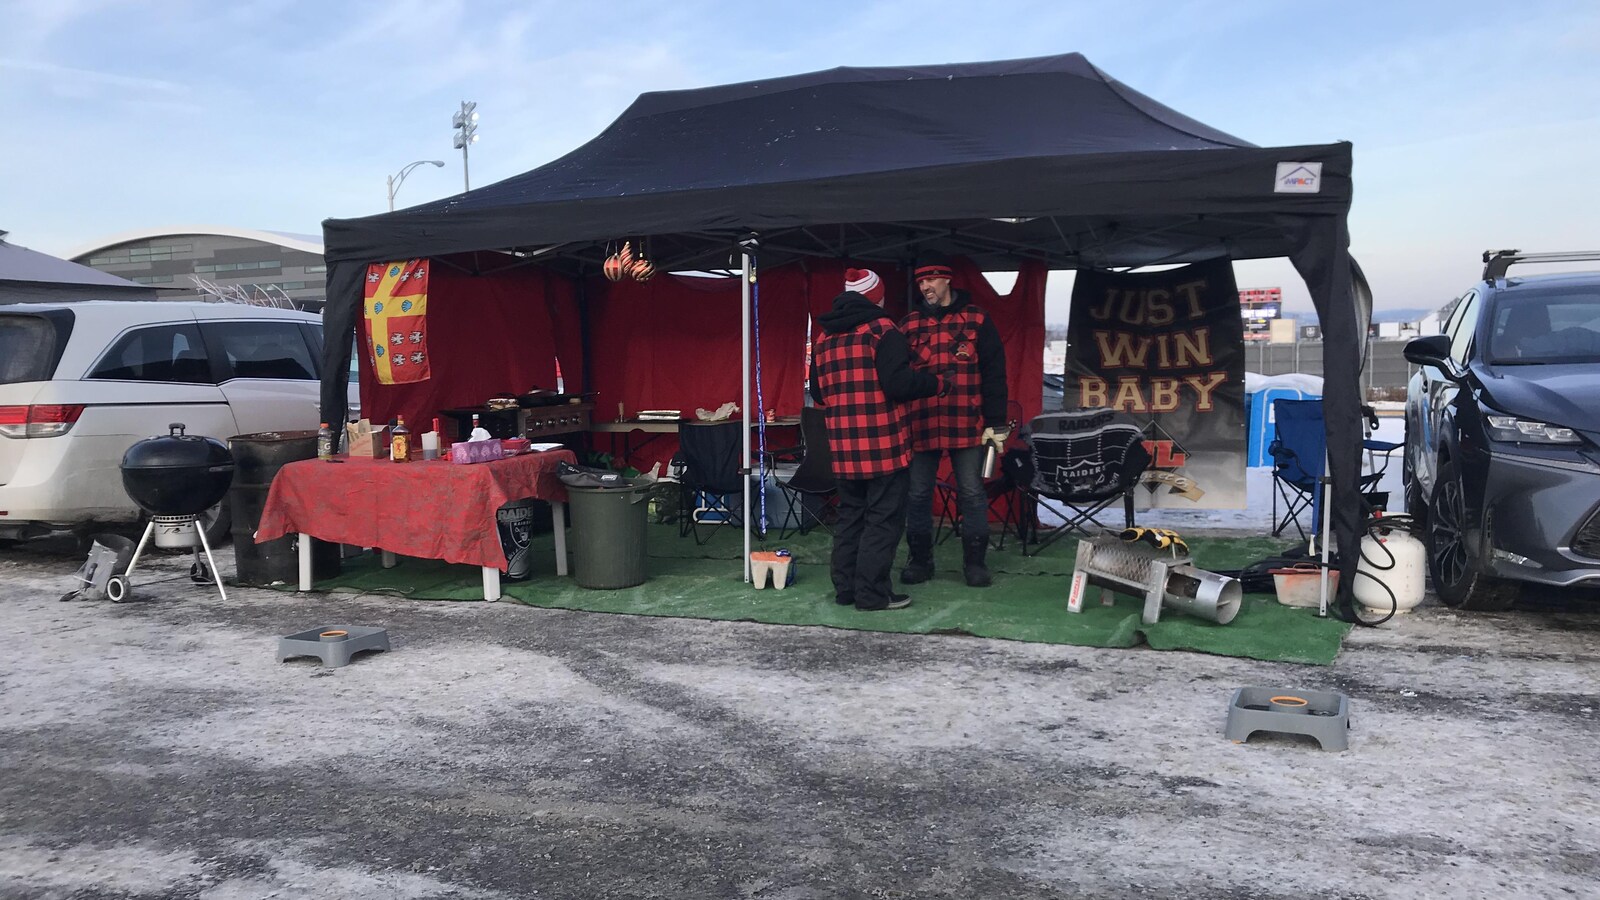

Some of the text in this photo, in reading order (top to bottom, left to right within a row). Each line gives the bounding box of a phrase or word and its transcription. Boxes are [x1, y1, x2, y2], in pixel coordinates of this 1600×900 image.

[1088, 279, 1207, 326] JUST
[1094, 327, 1213, 369] WIN
[1078, 371, 1228, 413] BABY
[1058, 412, 1115, 431] RAIDERS
[324, 442, 331, 450] G
[1062, 465, 1106, 478] RAIDERS
